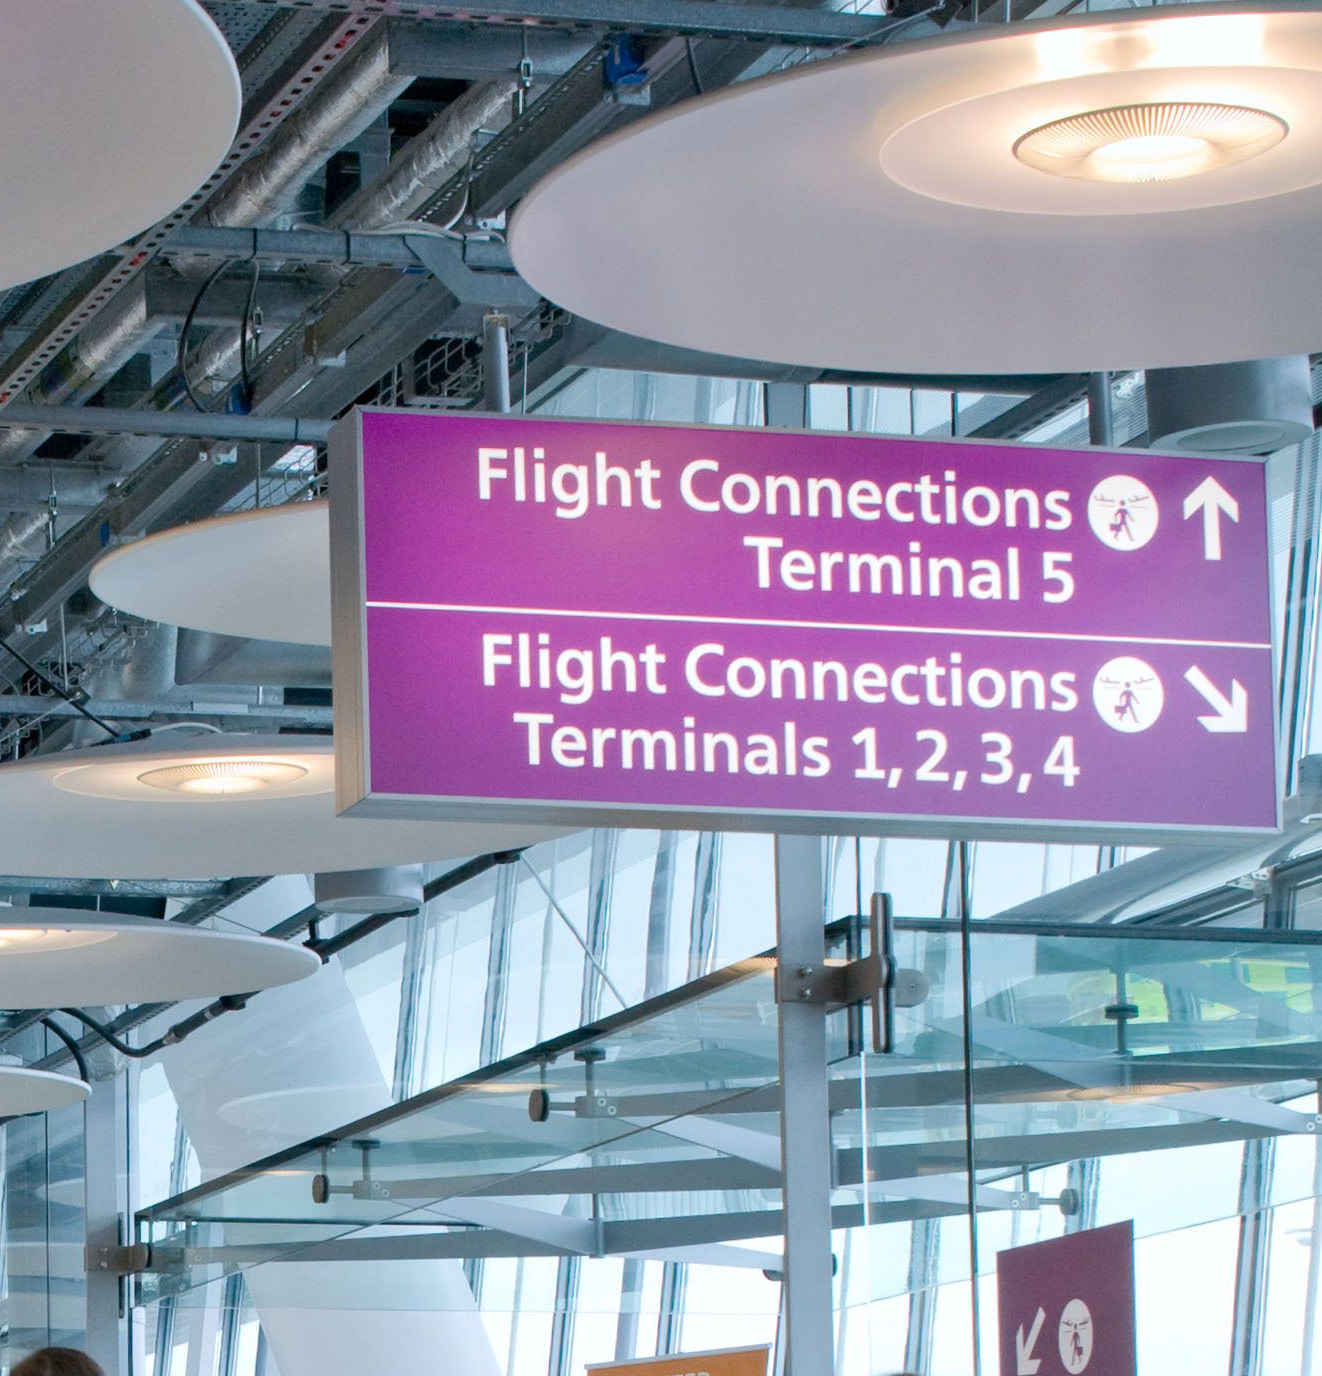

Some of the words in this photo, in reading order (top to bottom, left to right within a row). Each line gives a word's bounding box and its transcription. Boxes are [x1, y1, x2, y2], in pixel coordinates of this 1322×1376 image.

[478, 448, 661, 520] Flight
[679, 461, 1072, 531] Connections
[744, 536, 1021, 601] Terminal
[1043, 551, 1074, 604] 5
[482, 634, 666, 706] Flight
[684, 645, 1078, 713] Connections
[514, 712, 830, 779] Terminals
